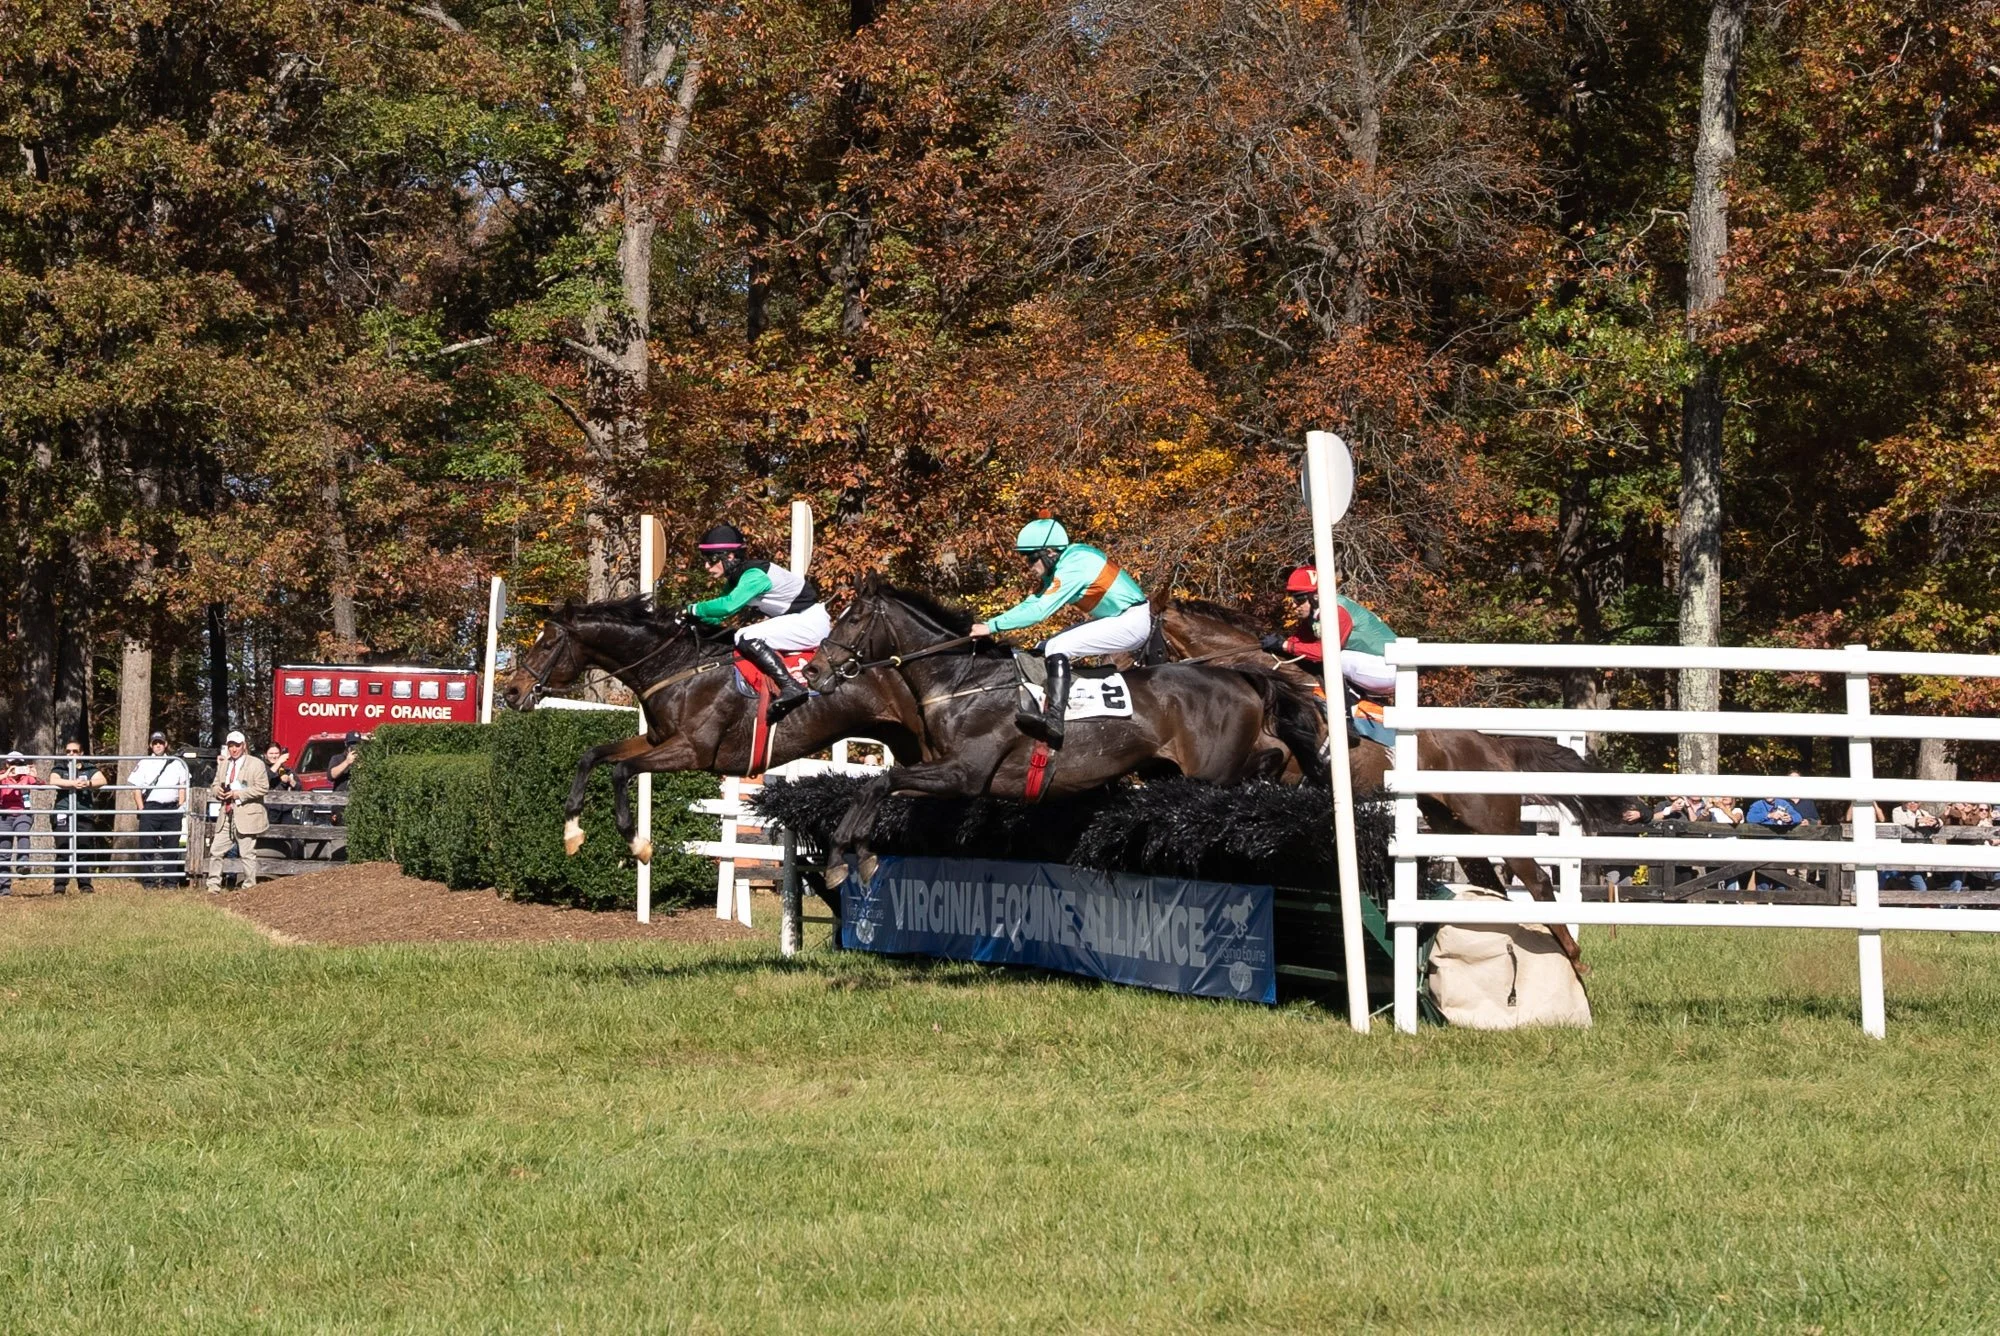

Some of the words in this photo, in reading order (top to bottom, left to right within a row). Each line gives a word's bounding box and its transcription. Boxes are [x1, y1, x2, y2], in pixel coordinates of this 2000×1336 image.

[1101, 683, 1126, 709] 2
[298, 702, 359, 717] COUNTY
[364, 704, 385, 718] OF
[390, 705, 452, 720] ORANGE
[889, 878, 987, 936] VIRGINIA
[990, 883, 1076, 952] EQUINE
[1079, 893, 1207, 968] ALLIANCE
